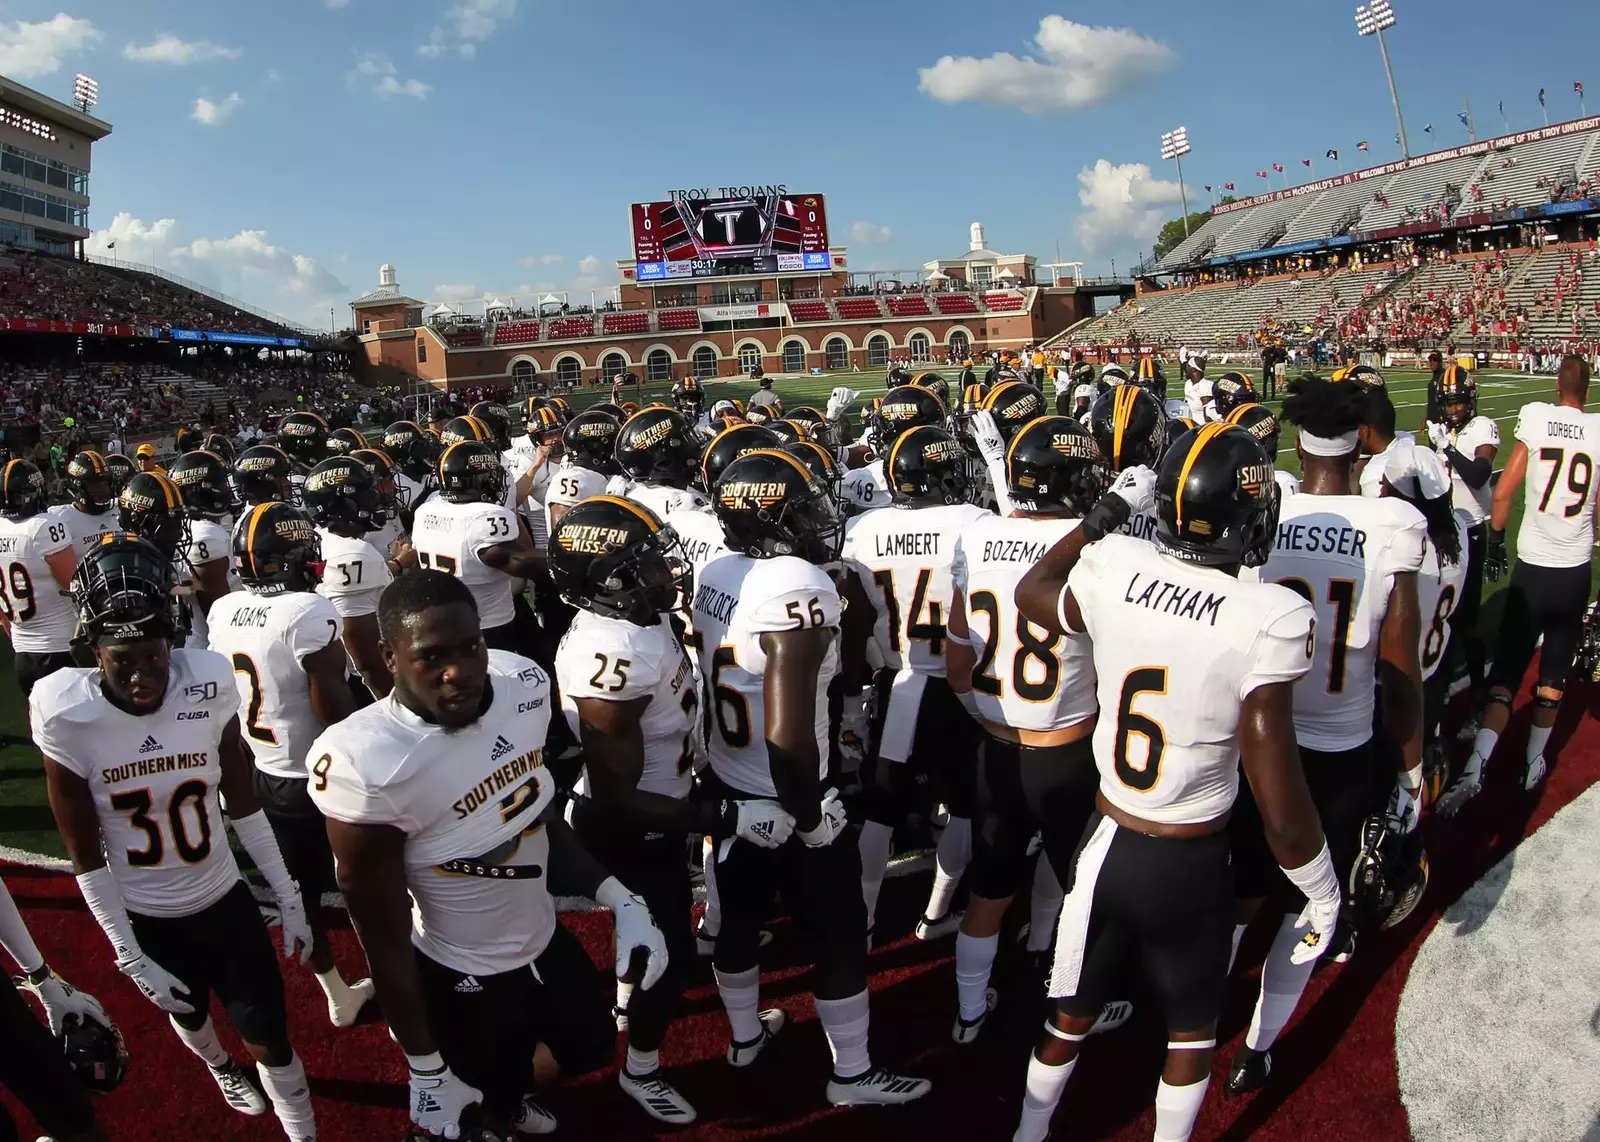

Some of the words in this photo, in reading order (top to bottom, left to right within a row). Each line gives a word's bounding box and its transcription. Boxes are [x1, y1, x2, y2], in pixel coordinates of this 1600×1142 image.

[1495, 136, 1516, 148] HOME
[1516, 133, 1526, 143] OF
[1527, 130, 1541, 141] THE
[1541, 126, 1561, 138] TROY
[1359, 167, 1386, 179] WELCOME
[1386, 164, 1395, 173] TO
[1395, 156, 1426, 172] VETRANS
[1426, 150, 1459, 163] MEMORIAL
[1459, 143, 1488, 157] STADIUM
[668, 188, 710, 202] TROY
[718, 184, 787, 200] TROJANS
[1230, 199, 1252, 211] MEDICAL
[644, 219, 652, 230] 0
[808, 211, 816, 222] 0
[691, 260, 717, 269] 30:17
[716, 309, 729, 317] Alfa
[87, 323, 104, 334] 30:17
[881, 403, 918, 412] SOUTHERN
[1001, 393, 1037, 416] SOUTHERN
[1018, 405, 1034, 418] MISS
[285, 423, 316, 432] SOUTHERN
[579, 423, 615, 432] SOUTHERN
[632, 419, 672, 447] SOUTHERN
[1547, 421, 1585, 441] DORBECK
[646, 432, 664, 448] MISS
[241, 457, 276, 466] SOUTHERN
[1070, 446, 1091, 459] MISS
[172, 467, 208, 480] SOUTHERN
[1538, 447, 1593, 519] 79
[560, 478, 579, 498] 55
[721, 481, 786, 498] SOUTHERN
[920, 484, 929, 493] 14
[1038, 484, 1048, 494] 28
[48, 522, 66, 543] 89
[292, 529, 310, 541] MISS
[487, 516, 510, 537] 33
[558, 524, 629, 544] SOUTHERN
[1222, 527, 1230, 539] 6
[197, 541, 209, 560] 8
[571, 537, 600, 554] MISS
[875, 532, 940, 558] LAMBERT
[982, 540, 1048, 565] BOZEMA
[283, 563, 289, 571] 2
[337, 560, 363, 587] 37
[1124, 572, 1227, 627] LATHAM
[230, 606, 272, 629] ADAMS
[785, 596, 826, 630] 56
[872, 567, 948, 656] 14
[113, 630, 144, 639] adidas
[969, 589, 1063, 704] 28
[517, 667, 546, 689] 150
[589, 652, 631, 692] 25
[184, 681, 218, 704] 150
[232, 651, 281, 748] 2
[1113, 665, 1169, 794] 6
[138, 742, 164, 754] adidas
[102, 755, 176, 785] SOUTHERN
[178, 752, 208, 770] MISS
[312, 753, 332, 791] 9
[451, 756, 529, 821] SOUTHERN
[109, 778, 212, 867] 30
[750, 824, 772, 842] adidas
[454, 984, 484, 993] adidas
